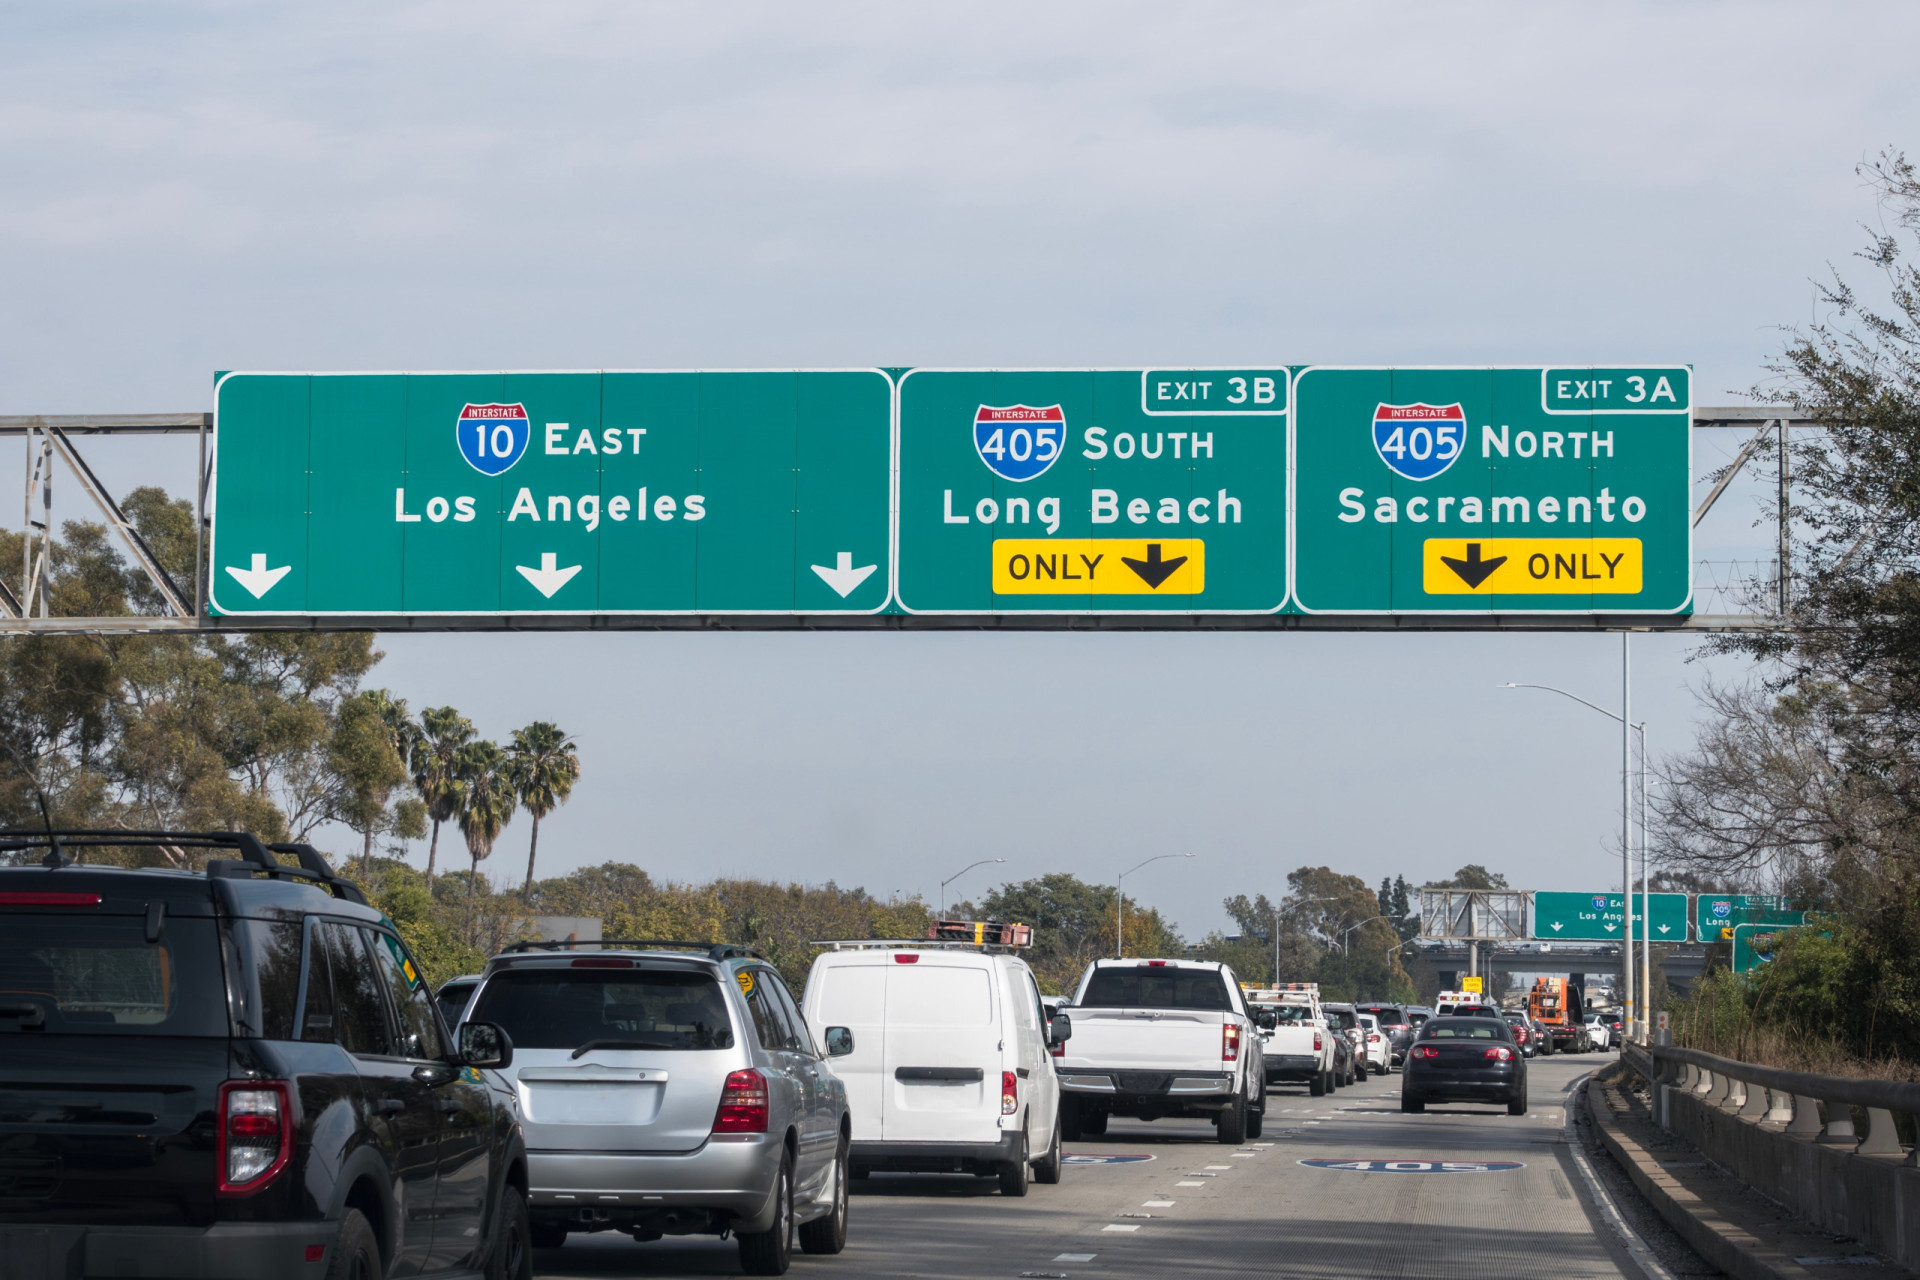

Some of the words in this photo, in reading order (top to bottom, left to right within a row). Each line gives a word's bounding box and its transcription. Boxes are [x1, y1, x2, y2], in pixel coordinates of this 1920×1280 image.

[1157, 381, 1212, 400] EXIT
[1227, 378, 1276, 404] 3B
[1557, 380, 1612, 399] EXIT
[1625, 375, 1676, 403] 3A
[469, 408, 518, 418] INTERSTATE
[991, 410, 1048, 419] INTERSTATE
[1391, 408, 1448, 418] INTERSTATE
[476, 424, 514, 458] 10
[544, 422, 647, 455] EAST
[981, 428, 1058, 462] 405
[1083, 427, 1215, 460] SOUTH
[1381, 426, 1459, 461] 405
[1482, 425, 1615, 459] NORTH
[395, 487, 476, 523] Los
[507, 486, 706, 532] Angeles
[943, 488, 1061, 535] Long
[1091, 488, 1242, 524] Beach
[1338, 487, 1647, 524] Sacramento
[1008, 554, 1104, 580] ONLY
[1528, 553, 1625, 579] ONLY
[1579, 911, 1597, 920] Los
[1602, 911, 1642, 923] Anges
[1596, 900, 1605, 908] 10
[1714, 905, 1729, 914] 405
[1706, 917, 1731, 927] Long
[1327, 1161, 1489, 1170] 405
